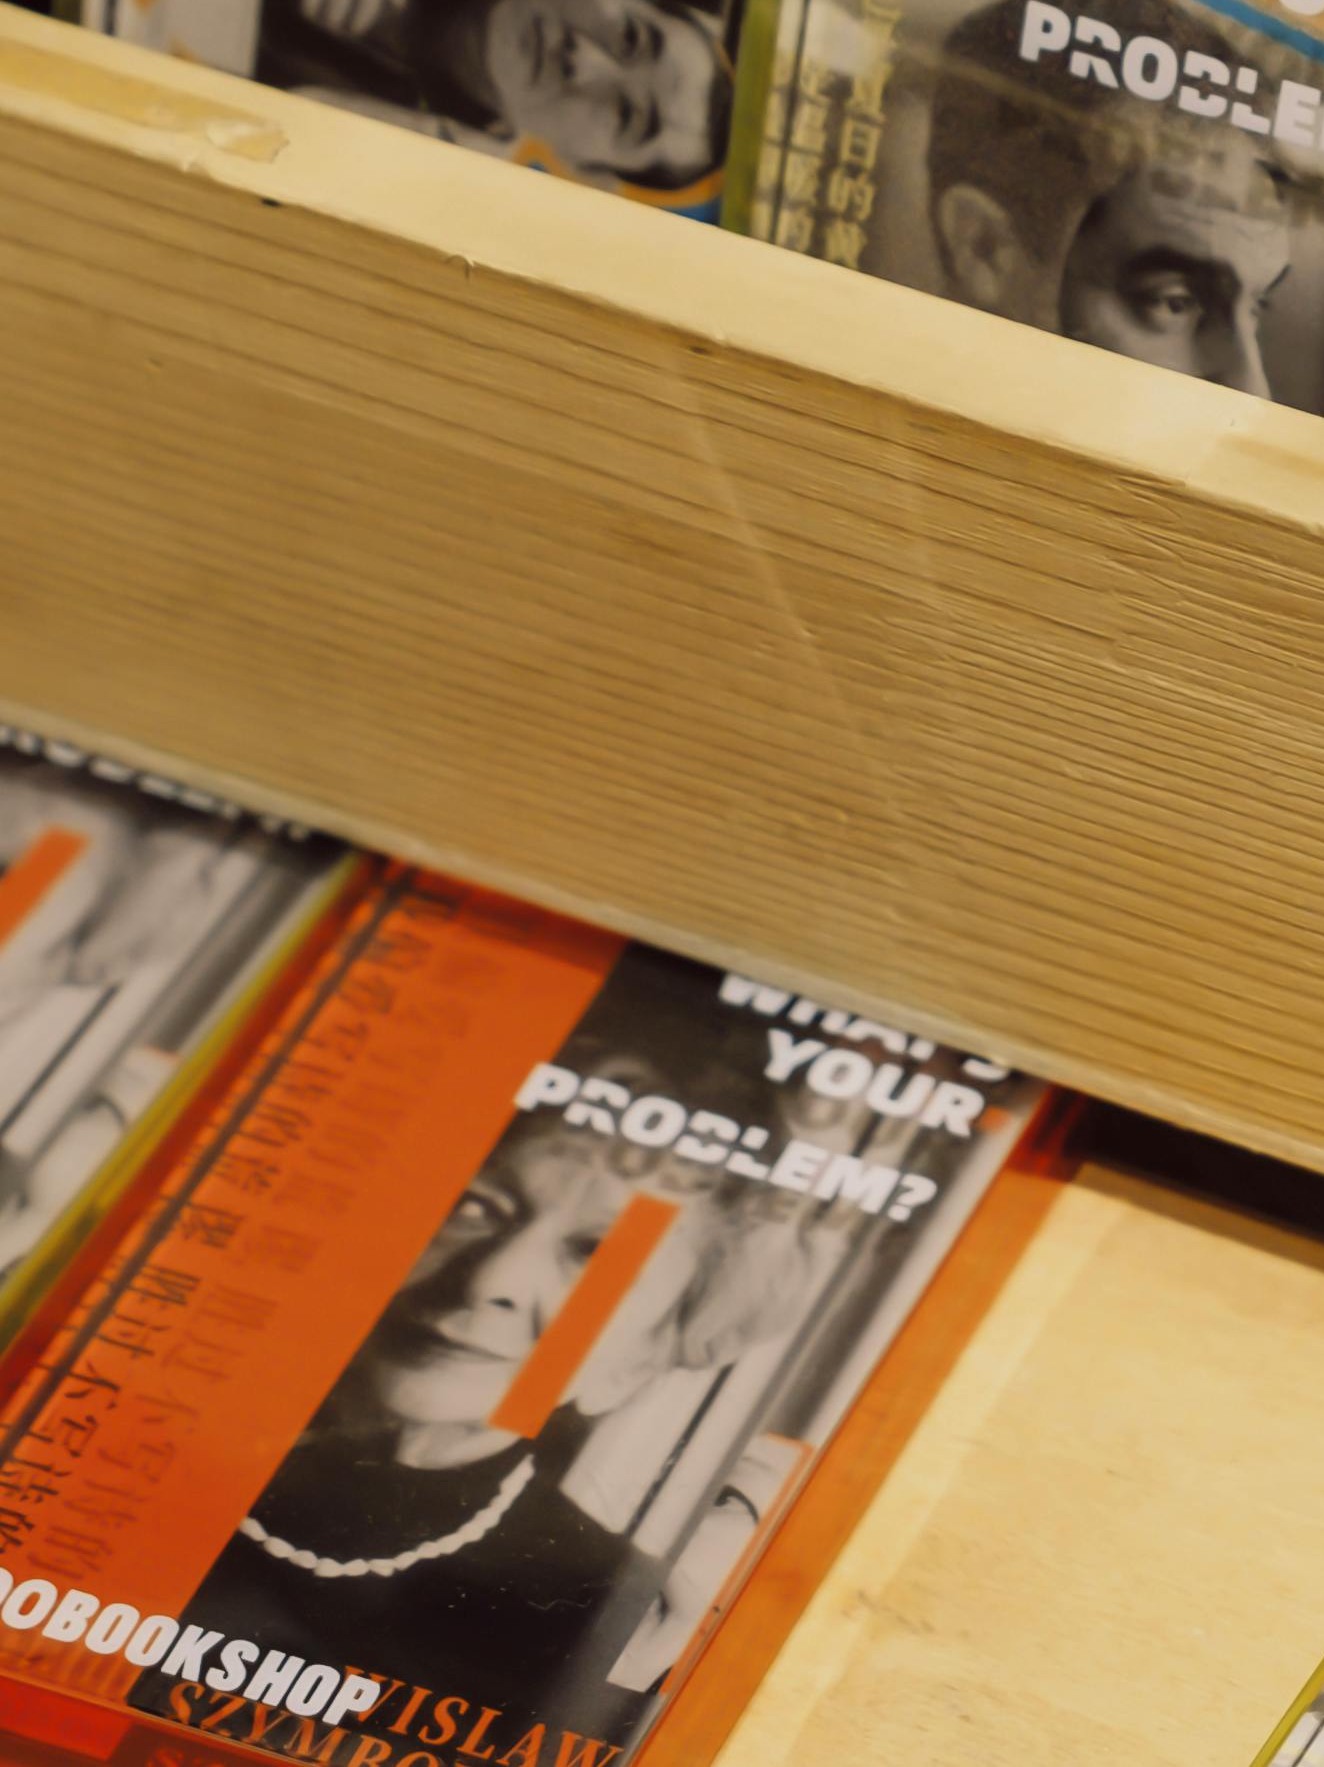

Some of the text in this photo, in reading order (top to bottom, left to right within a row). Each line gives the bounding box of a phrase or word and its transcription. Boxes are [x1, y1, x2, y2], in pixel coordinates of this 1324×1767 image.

[513, 1062, 938, 1222] PROBLEM?
[763, 1029, 986, 1137] YOUR
[0, 1567, 380, 1725] OBOOKSHOP
[168, 1681, 475, 1767] SZYMB
